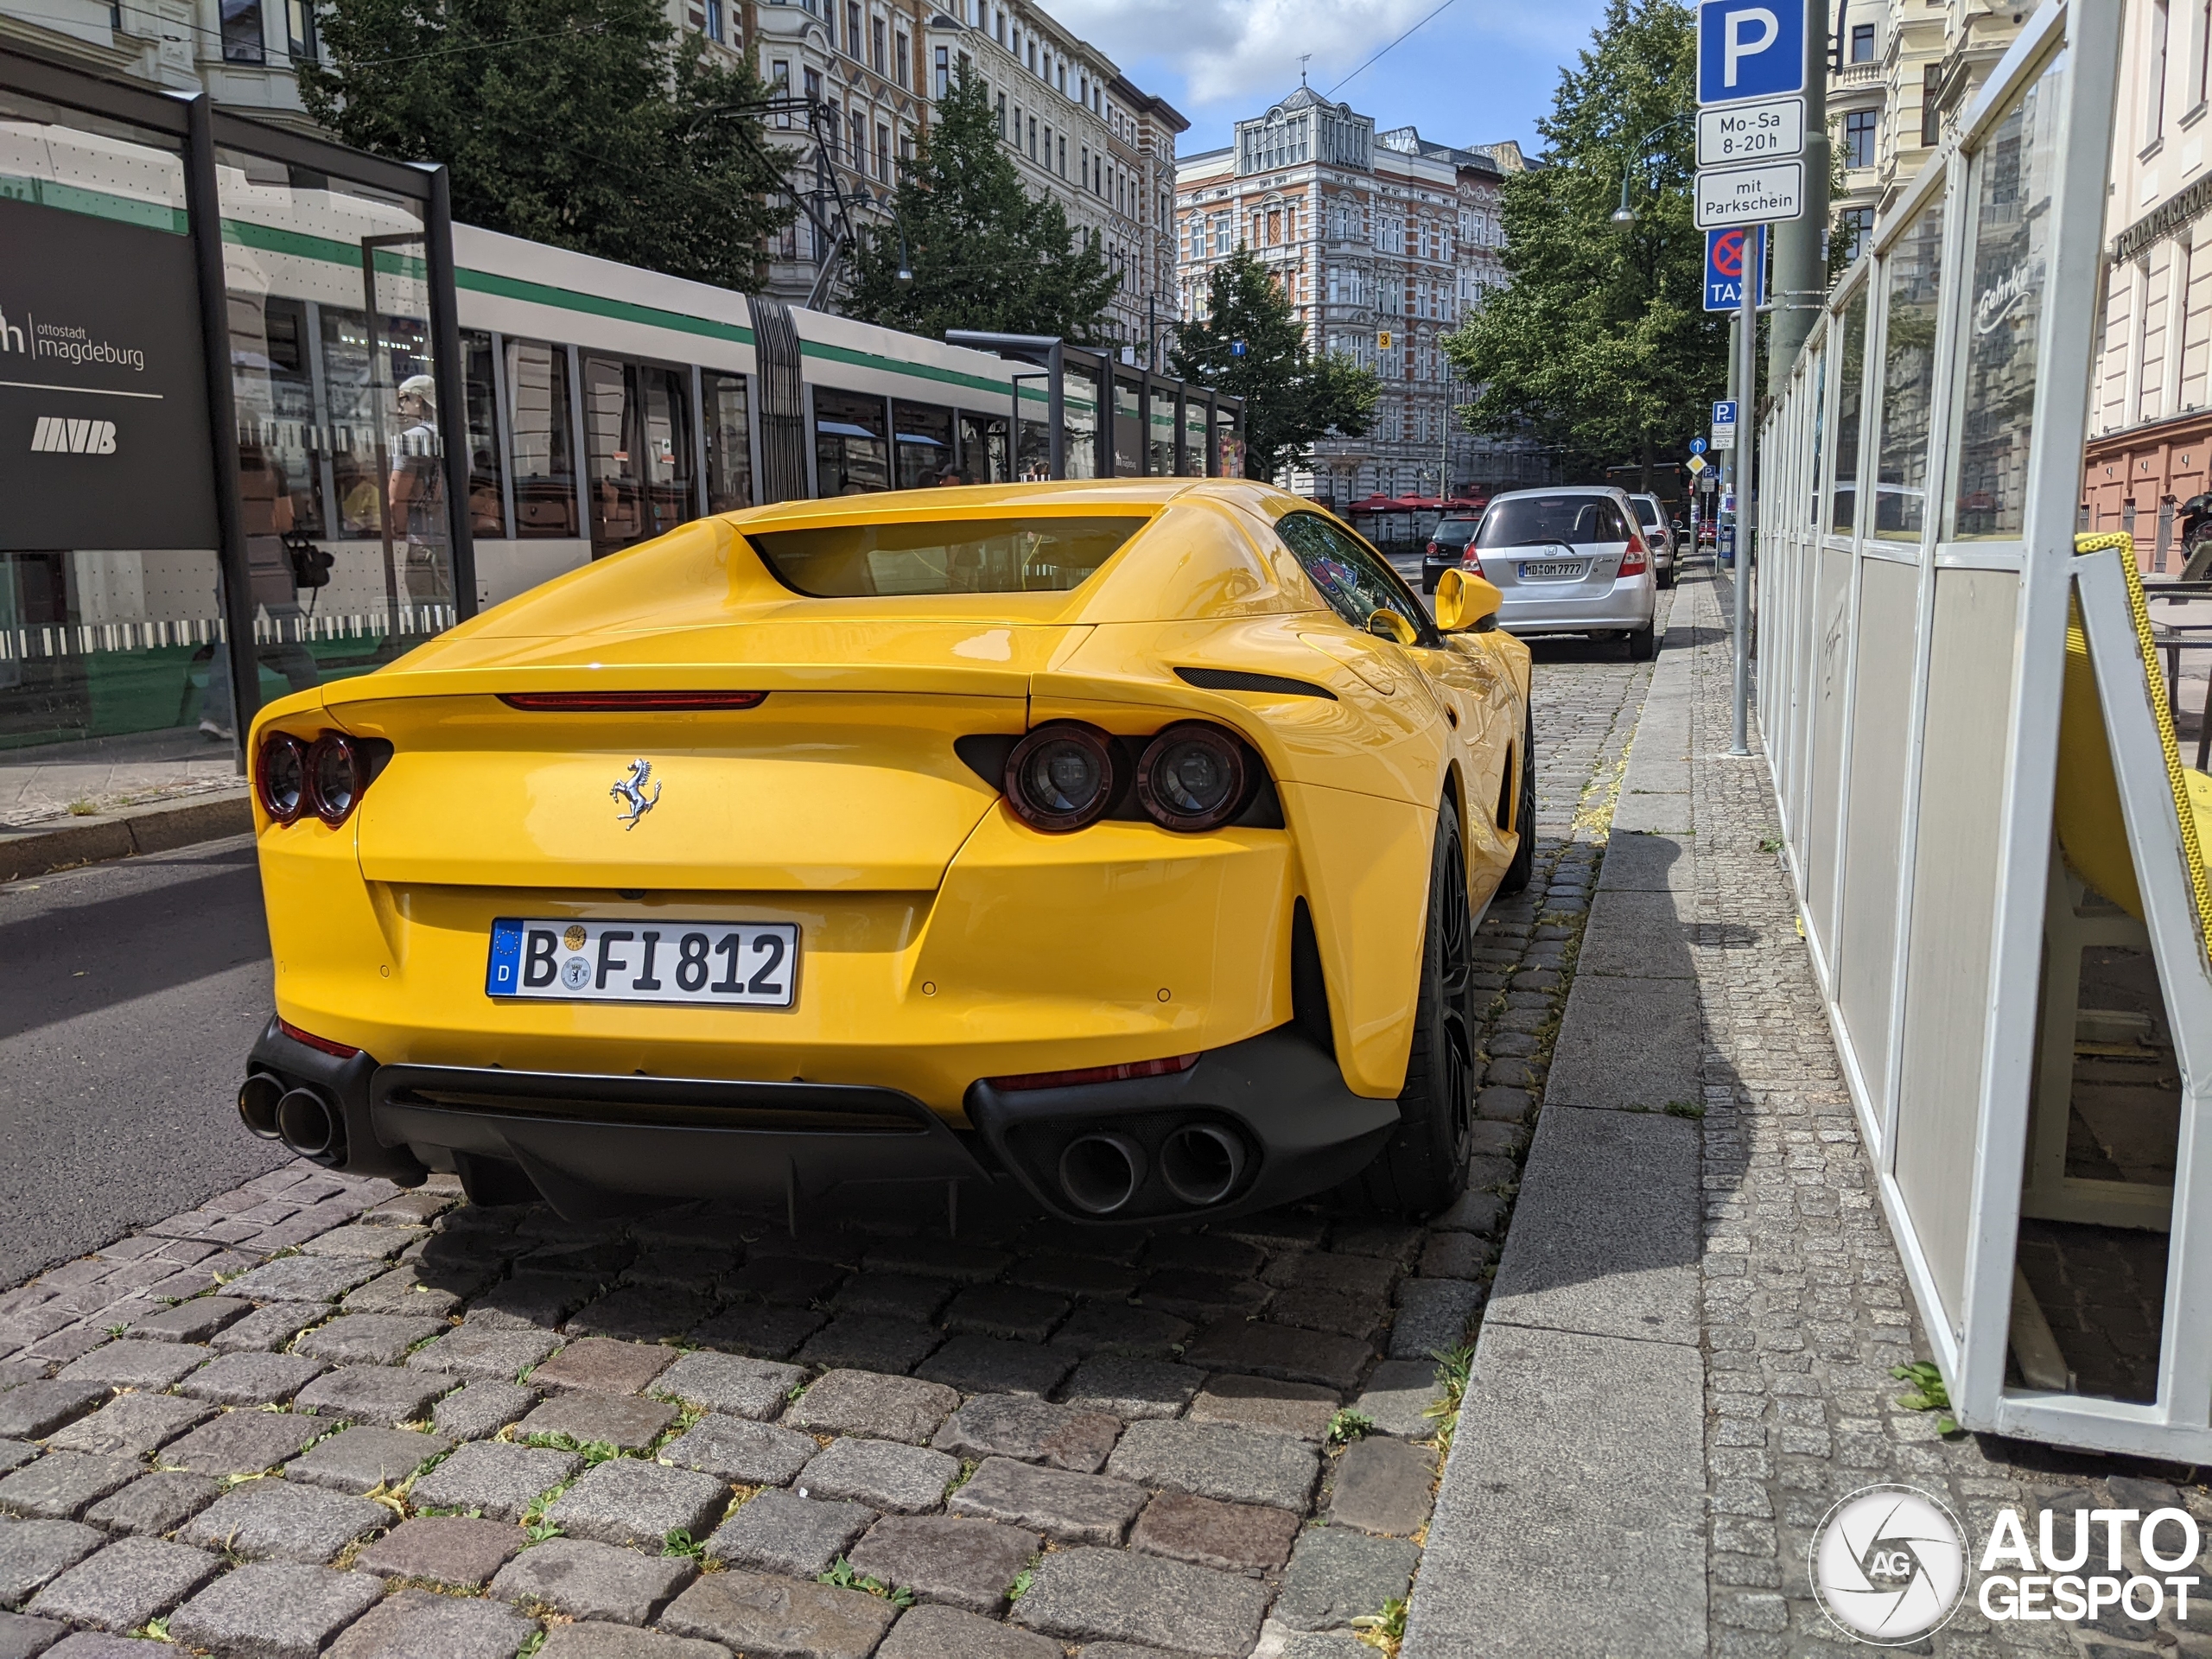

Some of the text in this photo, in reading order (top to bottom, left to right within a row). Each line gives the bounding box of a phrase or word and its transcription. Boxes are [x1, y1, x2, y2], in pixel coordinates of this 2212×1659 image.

[1724, 7, 1779, 87] P
[1720, 112, 1780, 133] Mo-Sa
[1737, 180, 1761, 194] mit
[1706, 194, 1792, 215] Parkschein
[1979, 264, 2028, 318] Gehrke
[37, 324, 86, 339] ottostadt
[1381, 335, 1388, 345] 3
[38, 340, 144, 371] magdeburg
[1235, 343, 1242, 353] T
[1716, 404, 1729, 421] P
[1525, 565, 1537, 575] MD
[1544, 564, 1556, 575] OM
[523, 930, 785, 994] B FI 812
[498, 965, 510, 982] D
